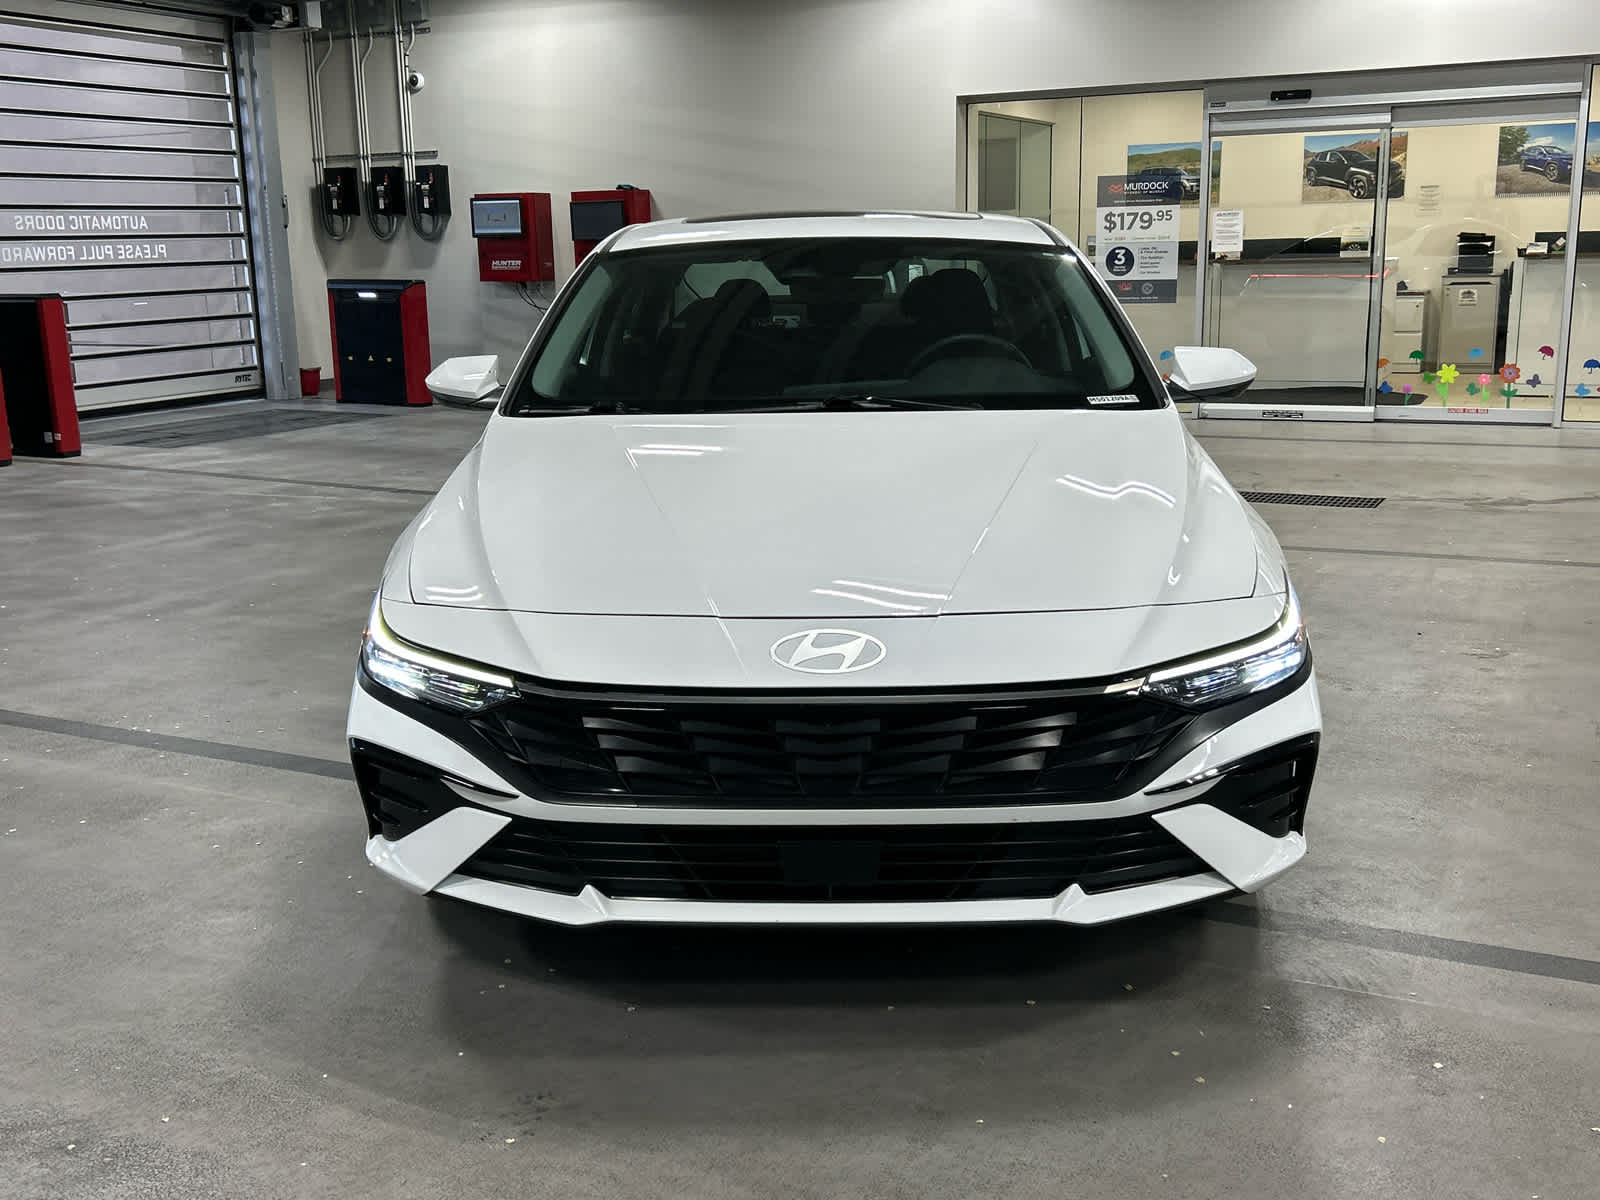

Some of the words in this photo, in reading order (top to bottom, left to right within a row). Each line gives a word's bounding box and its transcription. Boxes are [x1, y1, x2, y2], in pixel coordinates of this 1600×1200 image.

[1124, 181, 1169, 191] MURDOCK
[1104, 209, 1173, 233] $179.95
[1114, 249, 1126, 265] 3
